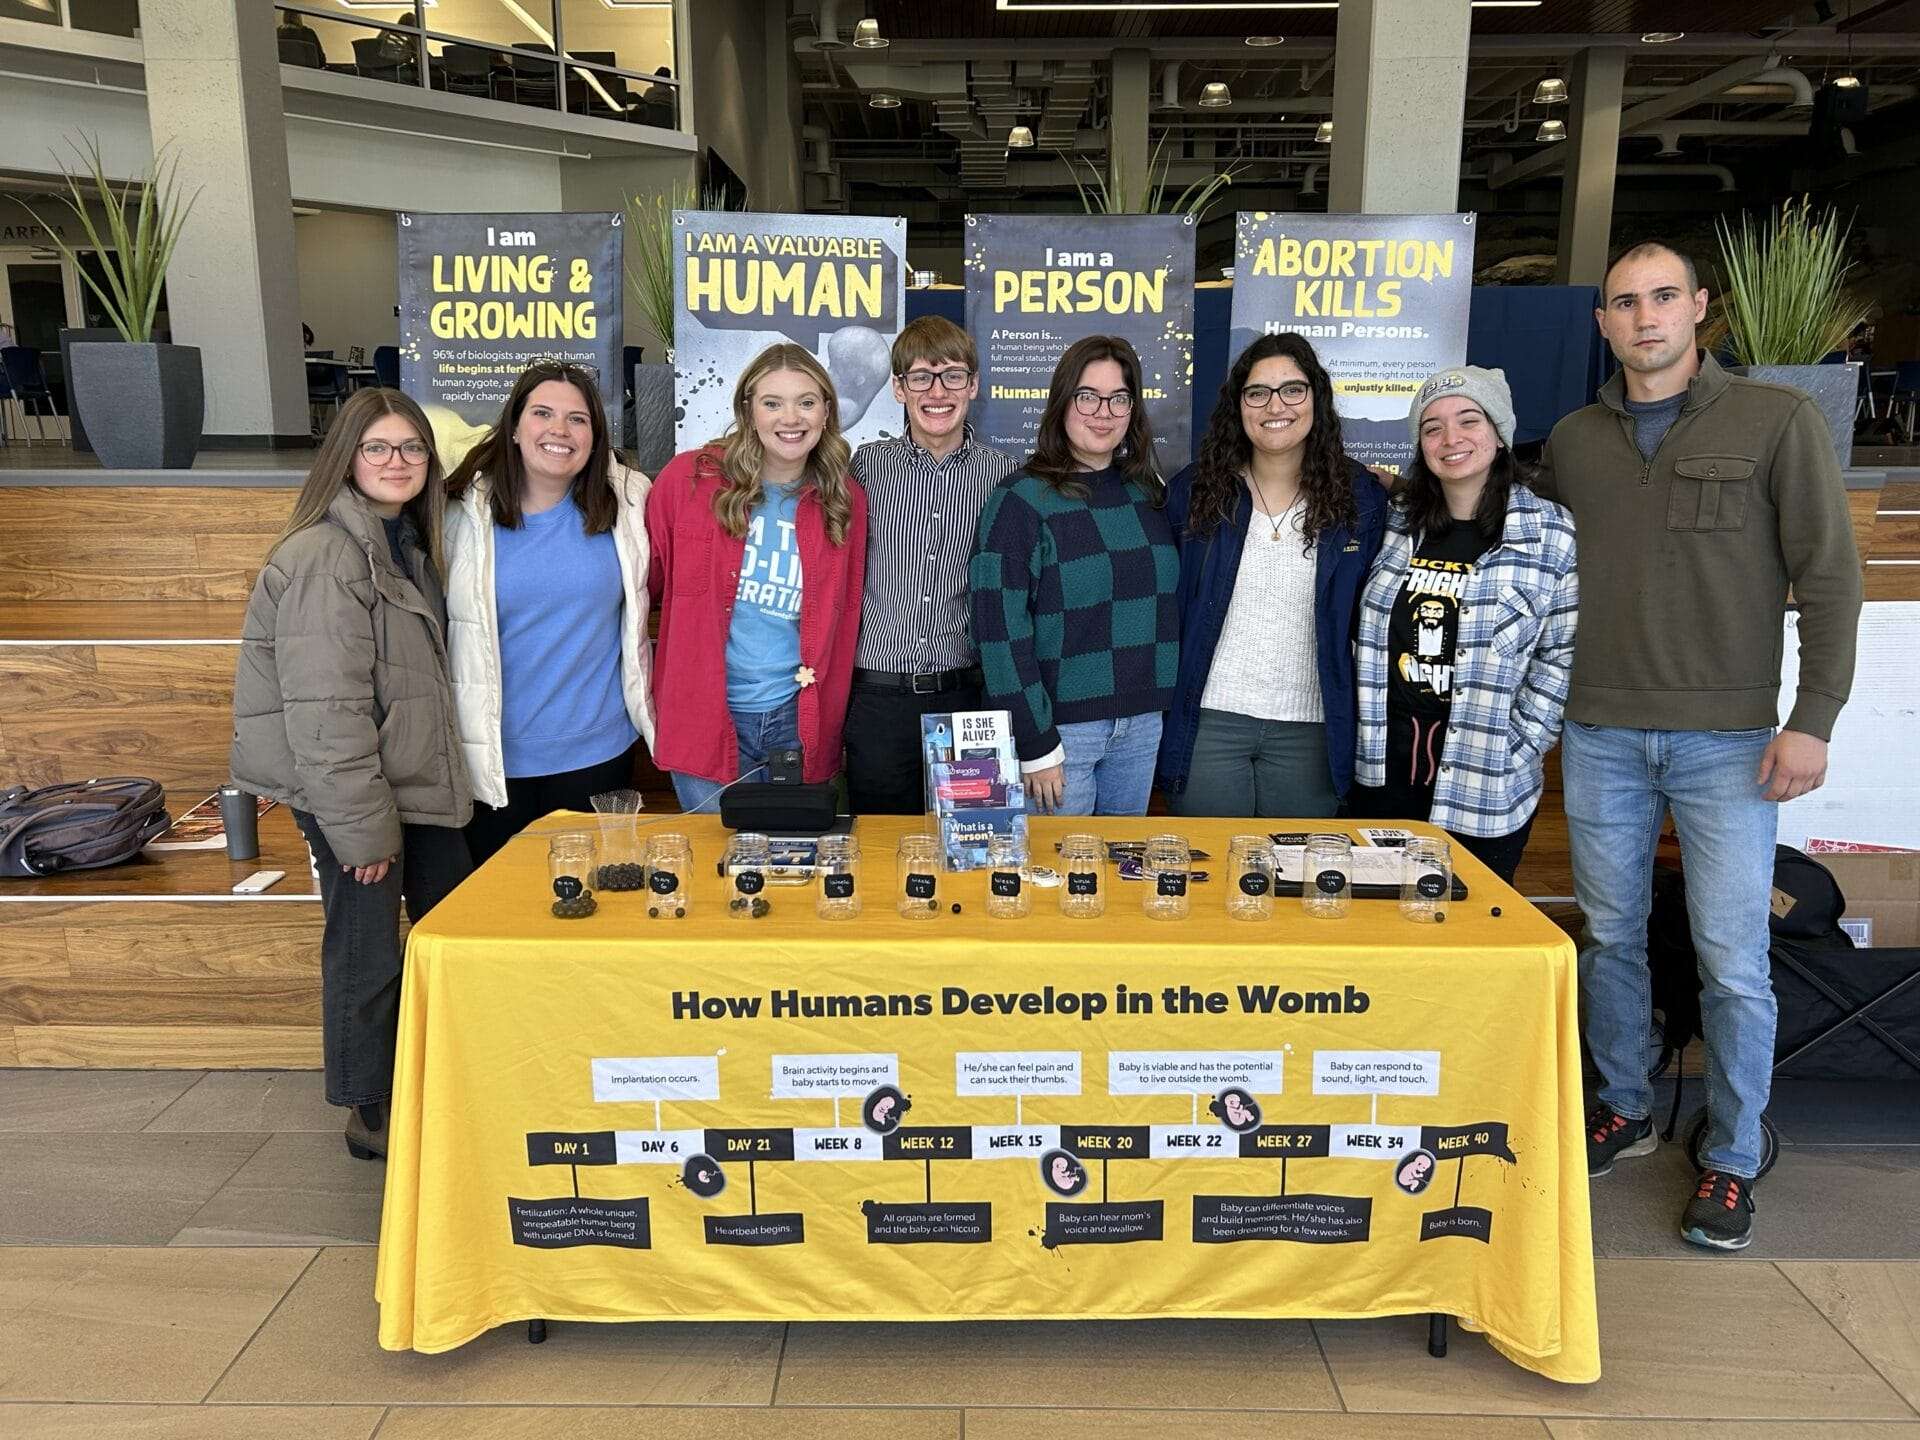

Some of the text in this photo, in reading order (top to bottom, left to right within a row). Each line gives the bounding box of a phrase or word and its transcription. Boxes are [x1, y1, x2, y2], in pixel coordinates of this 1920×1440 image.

[487, 227, 536, 246] I am
[686, 232, 882, 259] I AM A VALUABLE
[1046, 248, 1113, 266] I am a
[1253, 238, 1454, 279] ABORTION
[432, 255, 592, 293] LIVING &
[686, 256, 882, 318] HUMAN
[994, 270, 1165, 314] PERSON
[1295, 280, 1402, 317] KILLS
[430, 301, 597, 340] GROWING
[991, 330, 1039, 340] A Person
[1341, 322, 1429, 338] Persons.
[1023, 344, 1045, 352] being
[432, 350, 454, 360] 96%
[456, 350, 467, 360] of
[468, 350, 514, 362] biologists
[544, 351, 562, 360] that
[564, 351, 595, 360] human
[439, 364, 455, 373] life
[457, 364, 492, 375] begins
[494, 365, 505, 373] at
[1329, 359, 1338, 367] At
[1383, 361, 1405, 369] every
[1407, 361, 1436, 369] person
[991, 366, 1030, 374] necessary
[1379, 371, 1399, 379] right
[432, 378, 502, 389] human zygote,
[1345, 384, 1416, 393] unjustly killed.
[442, 392, 474, 402] rapidly
[963, 717, 994, 728] IS SHE
[963, 730, 995, 741] ALIVE?
[951, 822, 976, 832] What
[978, 822, 986, 830] is
[952, 831, 993, 841] Person?
[672, 984, 1370, 1020] How Humans Develop in the Womb
[783, 1065, 889, 1076] Brain activity begins and
[964, 1063, 998, 1073] He/she
[1017, 1063, 1034, 1071] feel
[1035, 1063, 1055, 1073] pain
[1056, 1063, 1074, 1071] and
[1118, 1062, 1273, 1073] Baby viable and has the potential
[1330, 1062, 1353, 1072] Baby
[1373, 1062, 1411, 1072] respond
[792, 1079, 814, 1088] baby
[988, 1075, 1008, 1084] suck
[1009, 1075, 1029, 1083] their
[1031, 1075, 1068, 1083] thumbs.
[1151, 1074, 1251, 1083] live outside the womb.
[1322, 1075, 1427, 1084] sound, and touch.
[727, 1139, 771, 1151] DAY 21
[814, 1138, 862, 1150] WEEK 8
[900, 1137, 954, 1149] WEEK 12
[989, 1135, 1043, 1148] WEEK 15
[1077, 1136, 1133, 1149] WEEK 20
[1167, 1135, 1222, 1147] WEEK 22
[1257, 1135, 1313, 1148] WEEK 27
[1346, 1135, 1404, 1149] WEEK 34
[1438, 1132, 1490, 1150] WEEK 40
[554, 1142, 577, 1154] DAY
[641, 1141, 679, 1153] DAY 6
[516, 1206, 568, 1217] Fertilization:
[1220, 1202, 1345, 1214] Baby differentiate voices
[523, 1218, 635, 1229] unrepeatable human being
[896, 1213, 976, 1224] organs formed
[1059, 1213, 1120, 1223] Baby hear
[1201, 1213, 1326, 1224] and build He/she
[541, 1228, 595, 1240] unique DNA
[715, 1224, 793, 1236] Heartbeat begins.
[874, 1225, 931, 1234] and the baby
[1064, 1225, 1107, 1234] voice and
[1213, 1225, 1278, 1236] been dreaming
